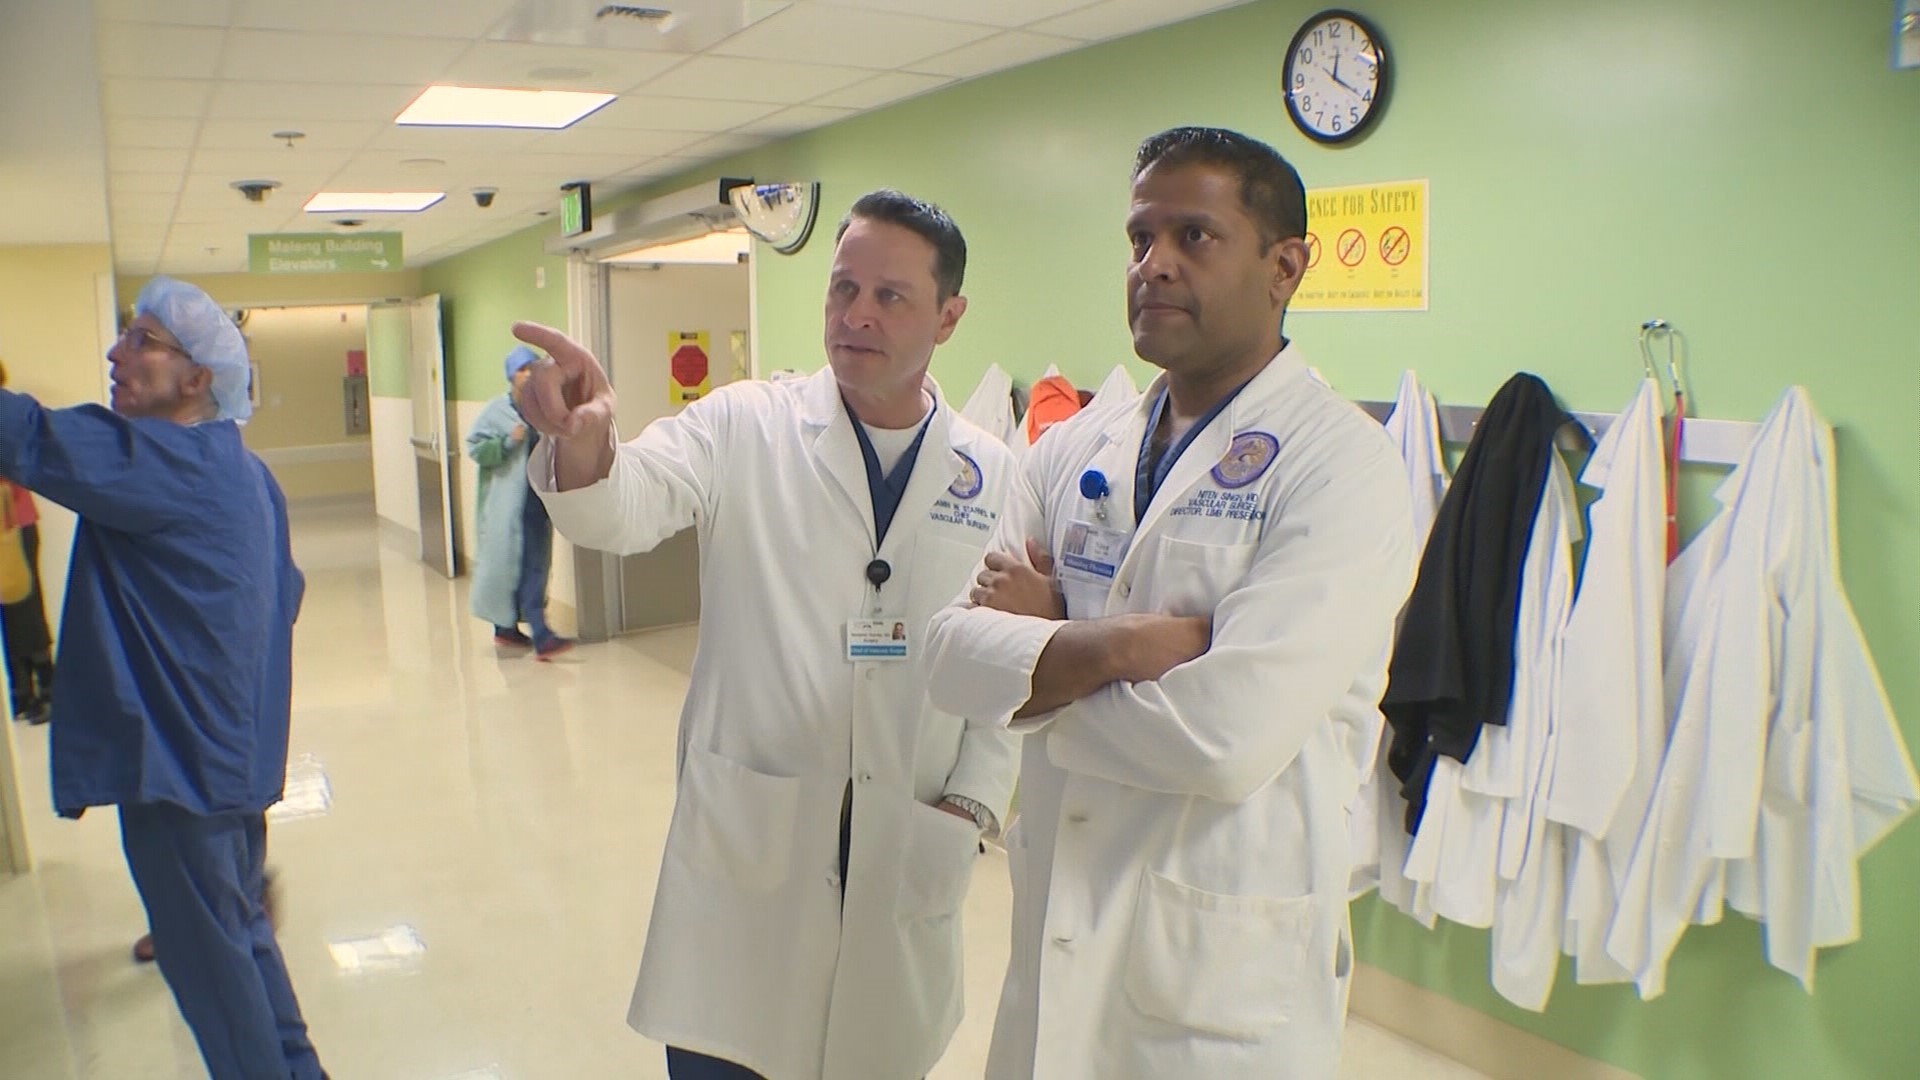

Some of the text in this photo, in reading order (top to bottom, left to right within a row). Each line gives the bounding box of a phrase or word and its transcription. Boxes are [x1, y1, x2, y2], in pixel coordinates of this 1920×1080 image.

[1313, 29, 1323, 47] 11
[1327, 21, 1341, 38] 12
[1350, 25, 1355, 41] 1
[1361, 39, 1371, 53] 2
[1300, 47, 1313, 65] 10
[1368, 63, 1378, 81] 3
[1295, 73, 1305, 90] 9
[1302, 95, 1311, 112] 8
[1362, 89, 1371, 102] 4
[1315, 111, 1324, 127] 7
[1331, 115, 1341, 132] 6
[1349, 106, 1359, 124] 5
[268, 238, 384, 255] Maleng Building
[269, 257, 337, 271] Elevators
[1188, 498, 1226, 509] VASCULAR
[929, 511, 964, 524] VASCULAR
